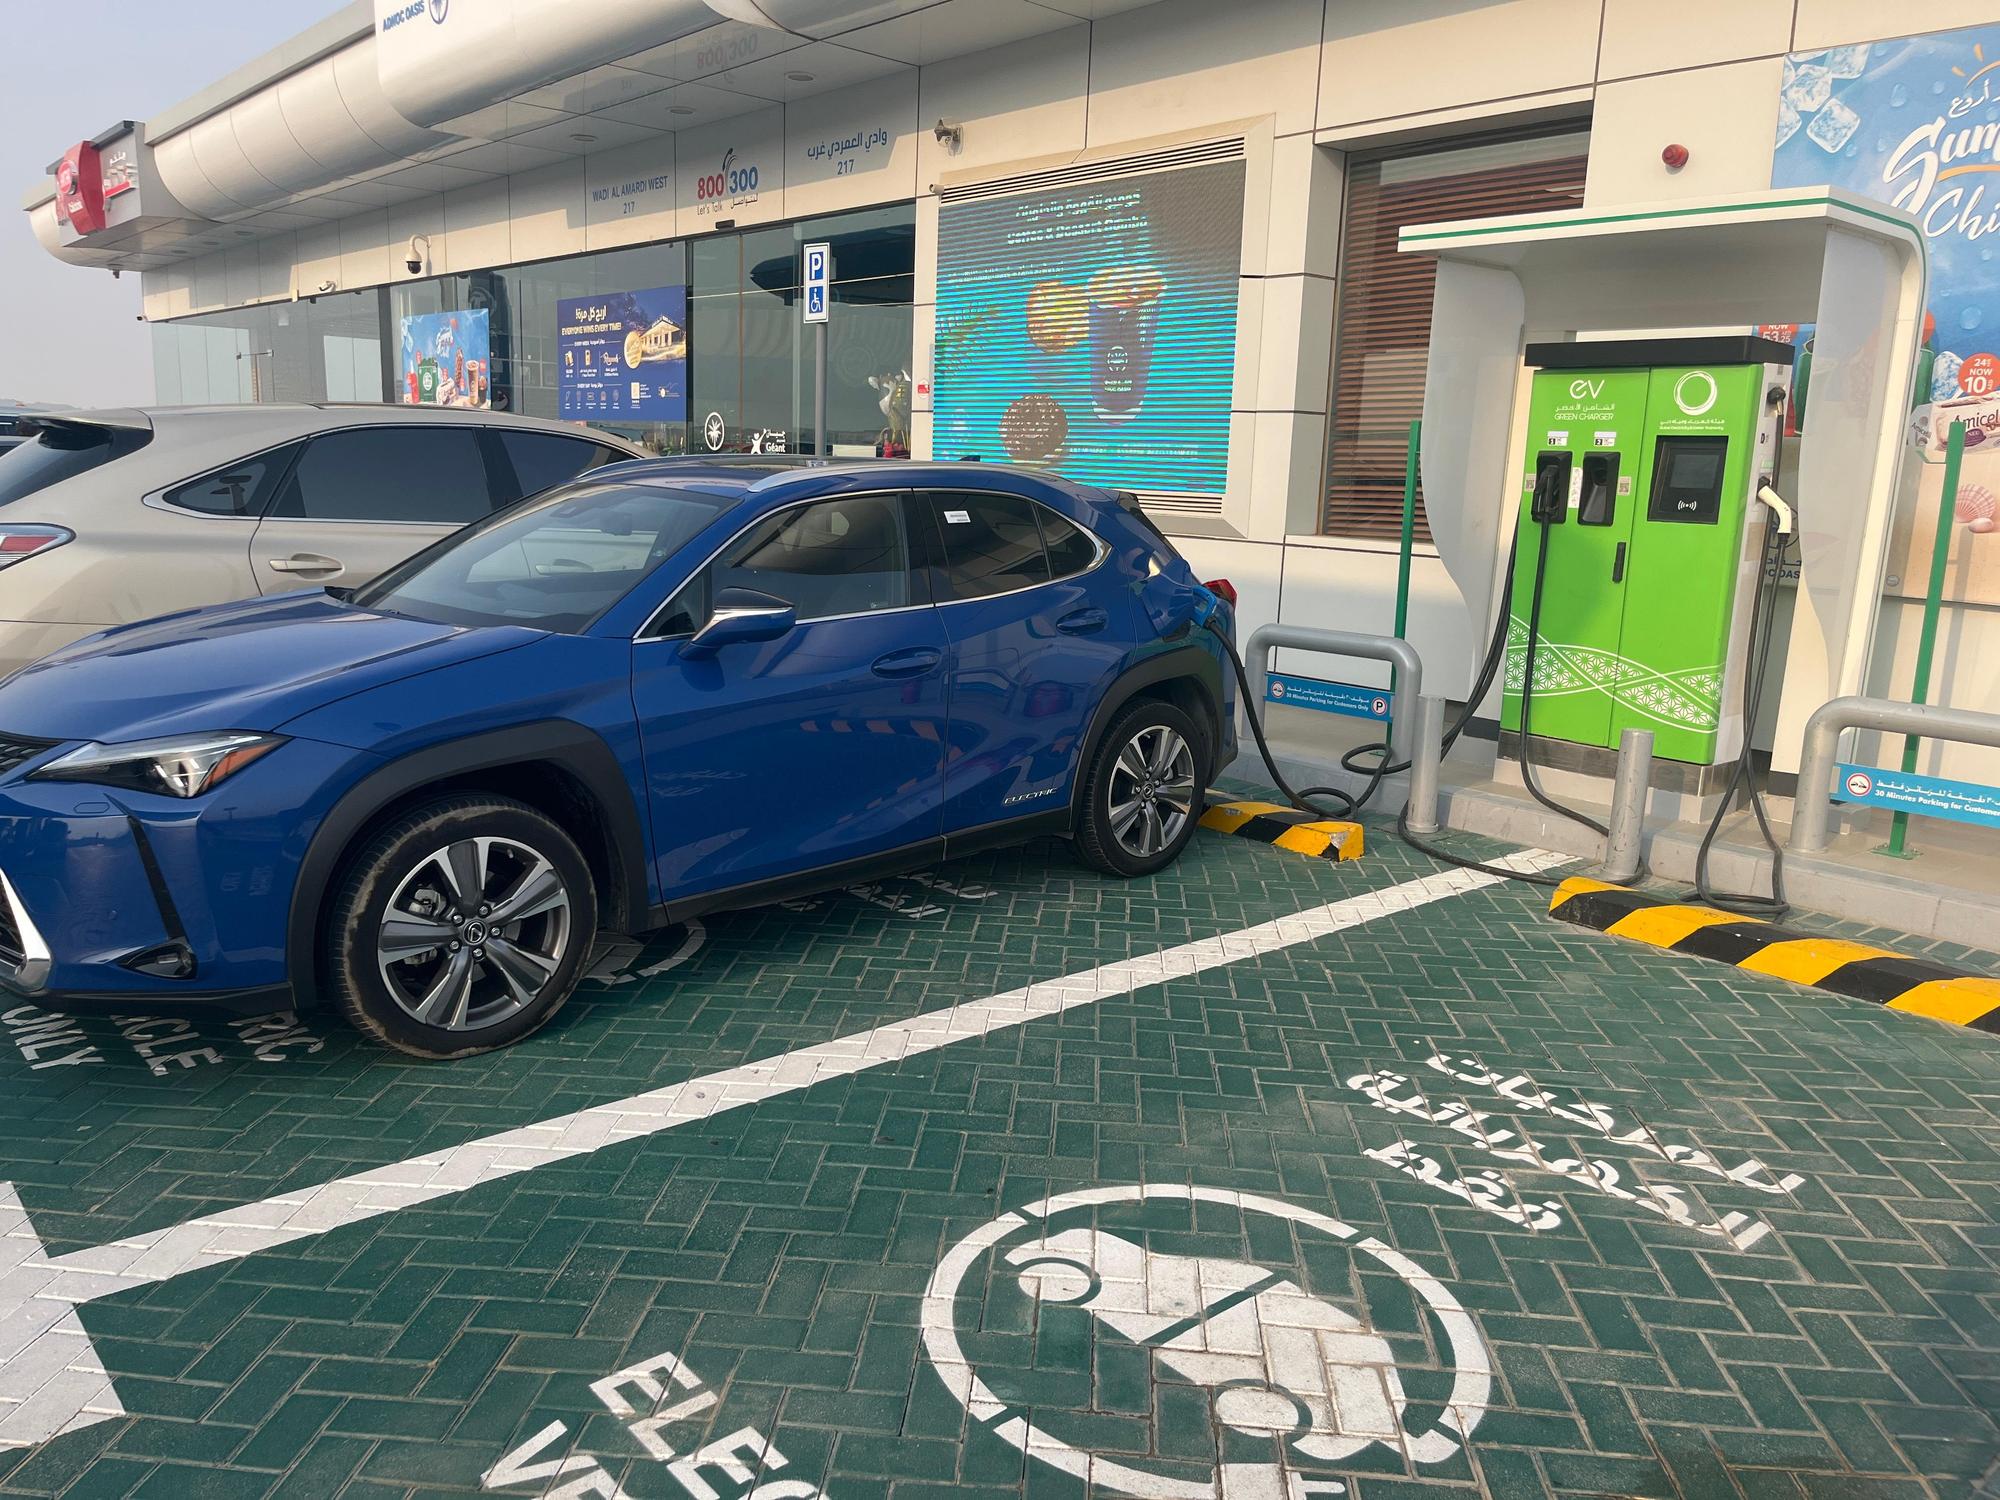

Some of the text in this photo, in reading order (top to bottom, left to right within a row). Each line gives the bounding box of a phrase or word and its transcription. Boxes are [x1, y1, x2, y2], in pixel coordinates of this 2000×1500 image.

[808, 128, 887, 160] وادي العمردي غرب
[838, 159, 855, 175] 217
[592, 175, 668, 202] WADI AL AMARDI WEST
[698, 166, 758, 200] 800 300
[623, 201, 635, 214] 217
[811, 253, 823, 280] P
[1969, 368, 1993, 376] NOW
[1964, 376, 1987, 393] 10
[1554, 413, 1614, 421] GREEN CHARGER
[766, 442, 786, 453] Géant
[1310, 696, 1326, 704] Parking
[1334, 701, 1357, 709] Customers
[1004, 787, 1058, 804] ELECTRIC
[1875, 789, 1885, 797] 30
[1886, 791, 1916, 803] Minutes
[1918, 797, 1949, 809] Parking
[1950, 801, 1962, 810] for
[1347, 1069, 1772, 1250] الكهربائية
[1363, 1139, 1563, 1231] فقط
